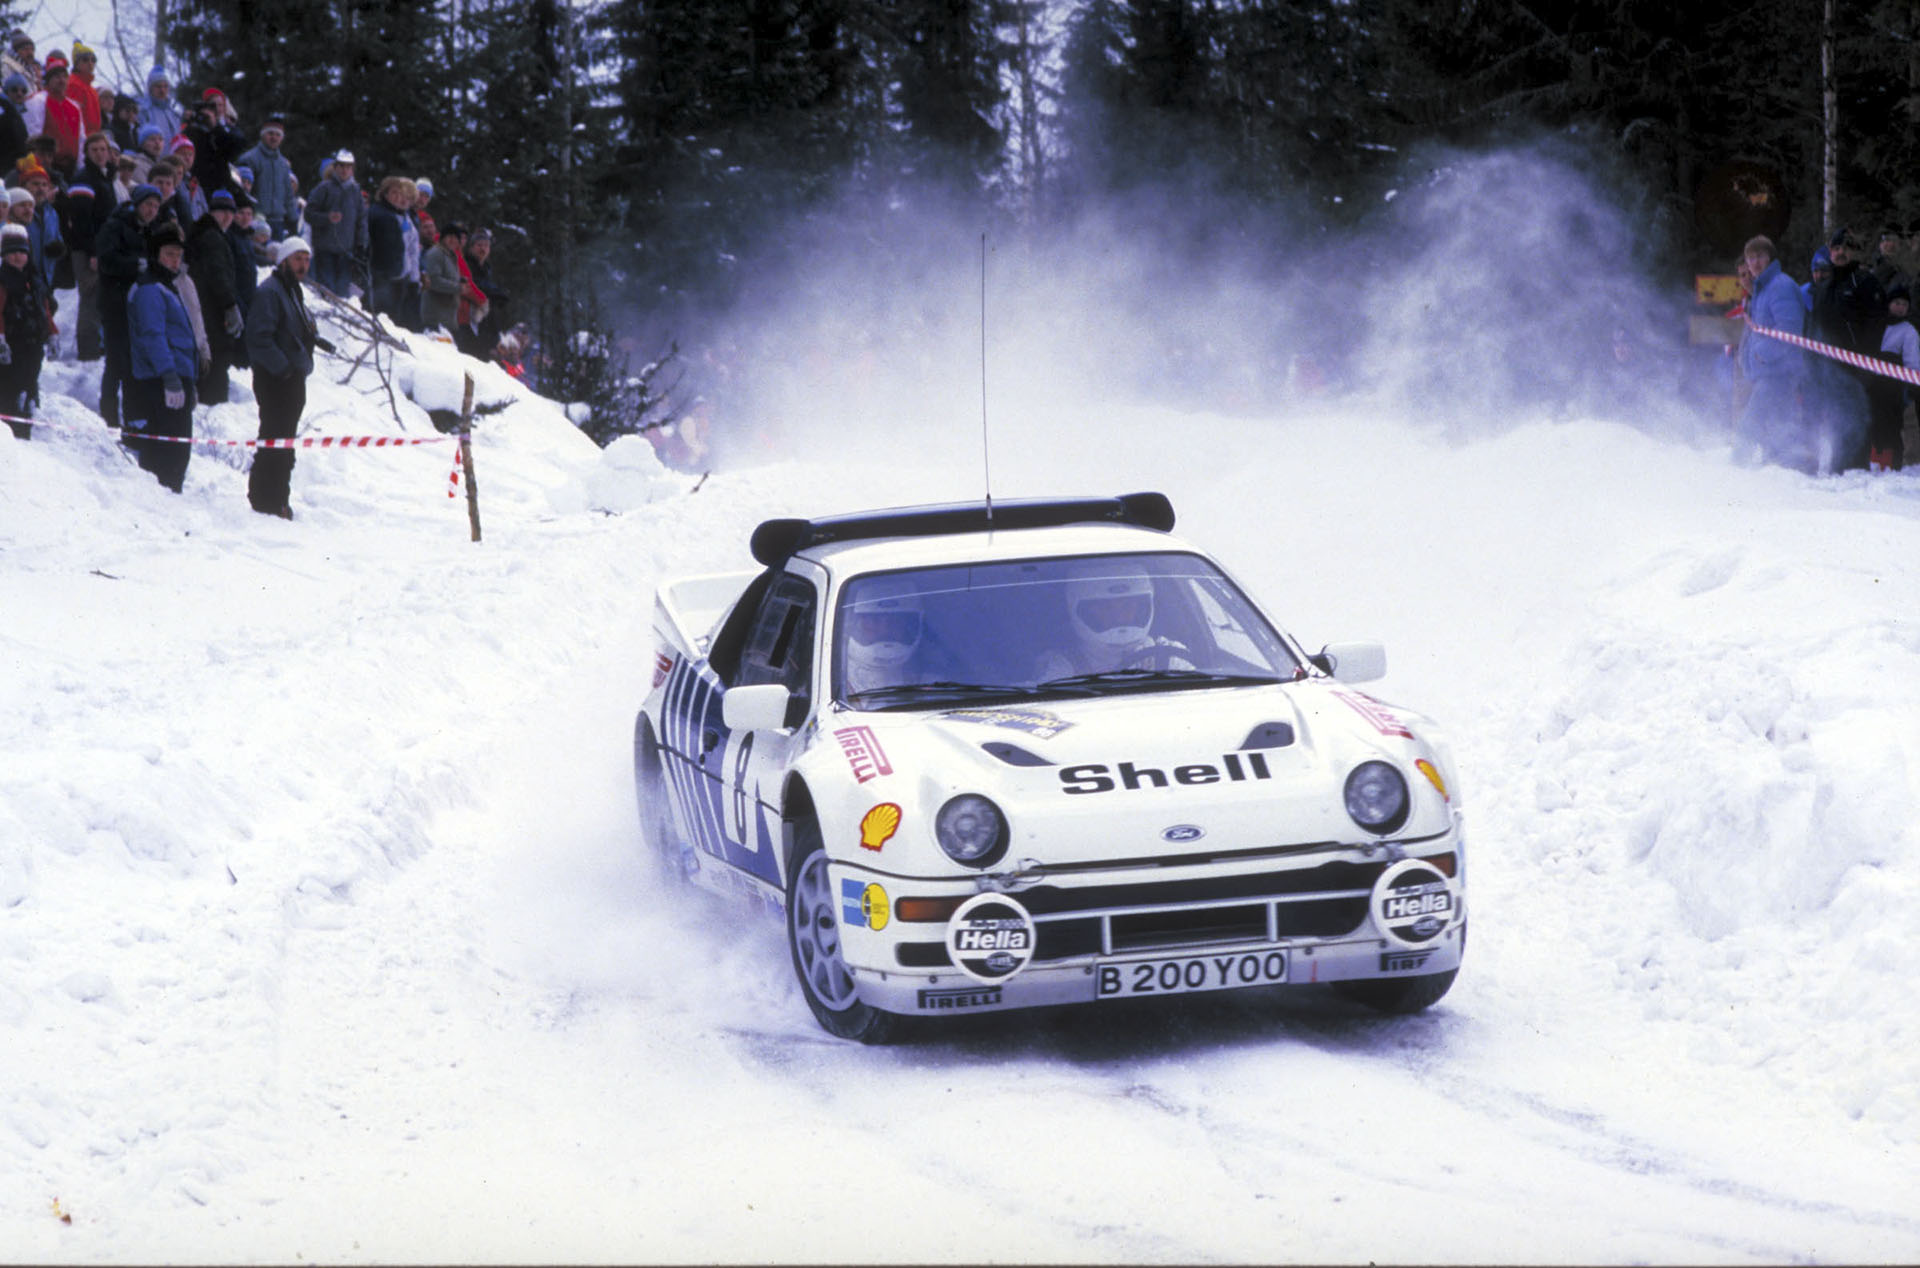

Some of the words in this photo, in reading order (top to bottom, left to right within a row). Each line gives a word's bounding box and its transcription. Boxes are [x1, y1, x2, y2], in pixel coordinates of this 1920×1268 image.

[833, 725, 894, 784] PIRELLI
[1059, 753, 1272, 795] Shell
[1387, 893, 1448, 918] Hella
[960, 930, 1026, 950] Hella
[917, 985, 1003, 1009] PIRELLI
